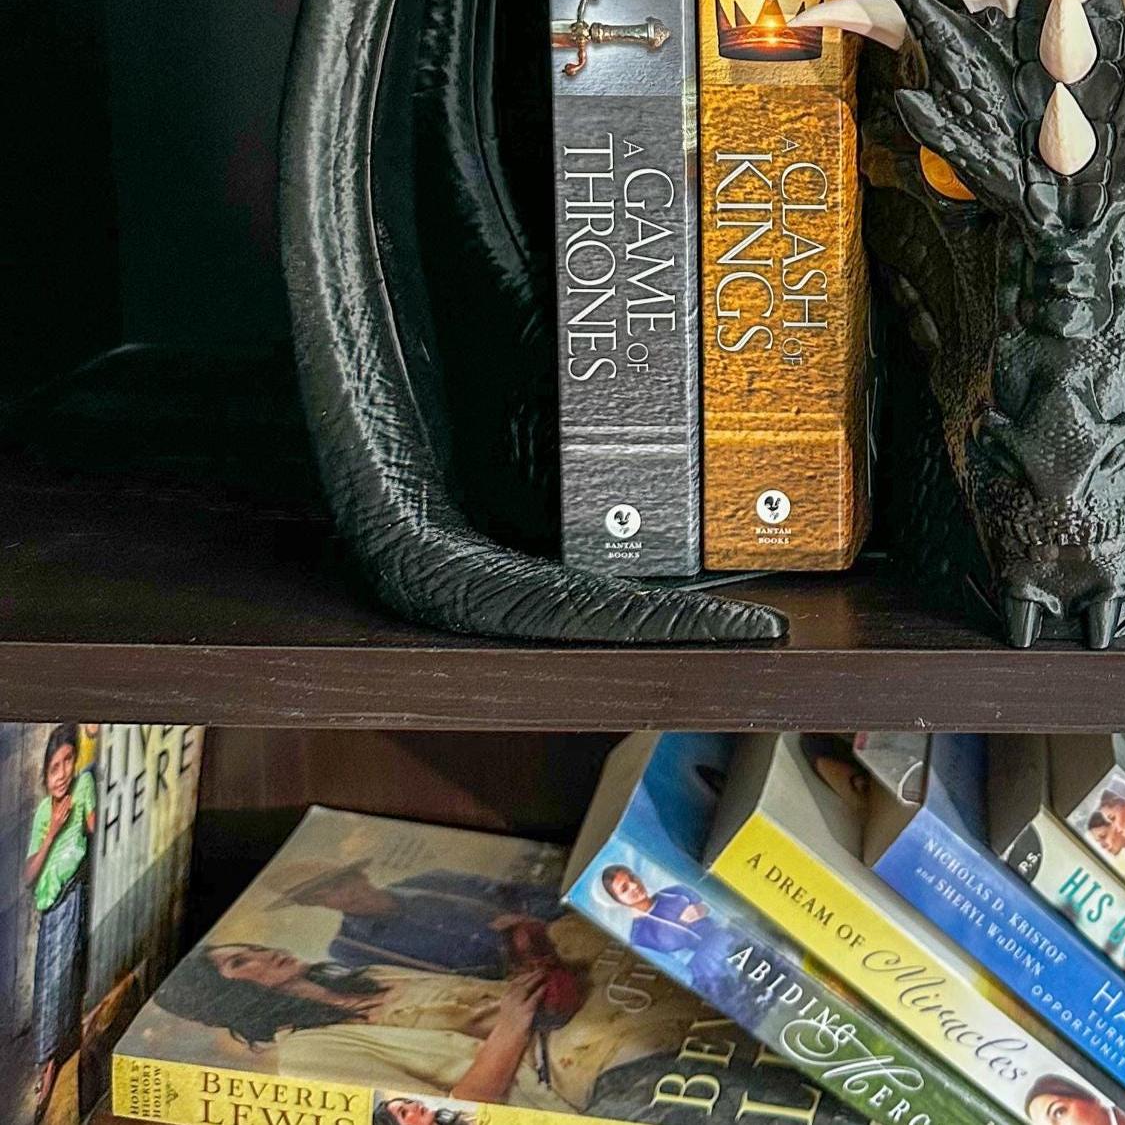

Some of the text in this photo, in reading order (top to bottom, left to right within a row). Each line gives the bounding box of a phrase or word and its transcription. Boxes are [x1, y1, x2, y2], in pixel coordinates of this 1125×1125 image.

[563, 132, 618, 382] THRONES
[622, 139, 676, 374] A GAME OF
[715, 150, 775, 353] KINGS
[780, 136, 829, 366] A CLASH OF
[605, 542, 643, 550] BANTAM
[608, 551, 641, 559] BOOKS
[755, 527, 793, 536] BANTAM
[758, 537, 790, 545] BOOKS
[924, 838, 1068, 966] NICHOLAS D. KRISTOF
[1059, 867, 1113, 923] HIS
[934, 880, 983, 929] SHERYL
[986, 925, 1045, 977] WuDUNN
[746, 851, 761, 871] A
[765, 864, 834, 927] DREAM
[836, 923, 866, 949] OF
[862, 950, 1028, 1082] Miracles
[727, 946, 856, 1044] ABIDING
[131, 1075, 140, 1115] HOME
[141, 1064, 151, 1117] HICKORY
[153, 1066, 161, 1118] HOLLOW
[201, 1071, 360, 1112] BEVERLY
